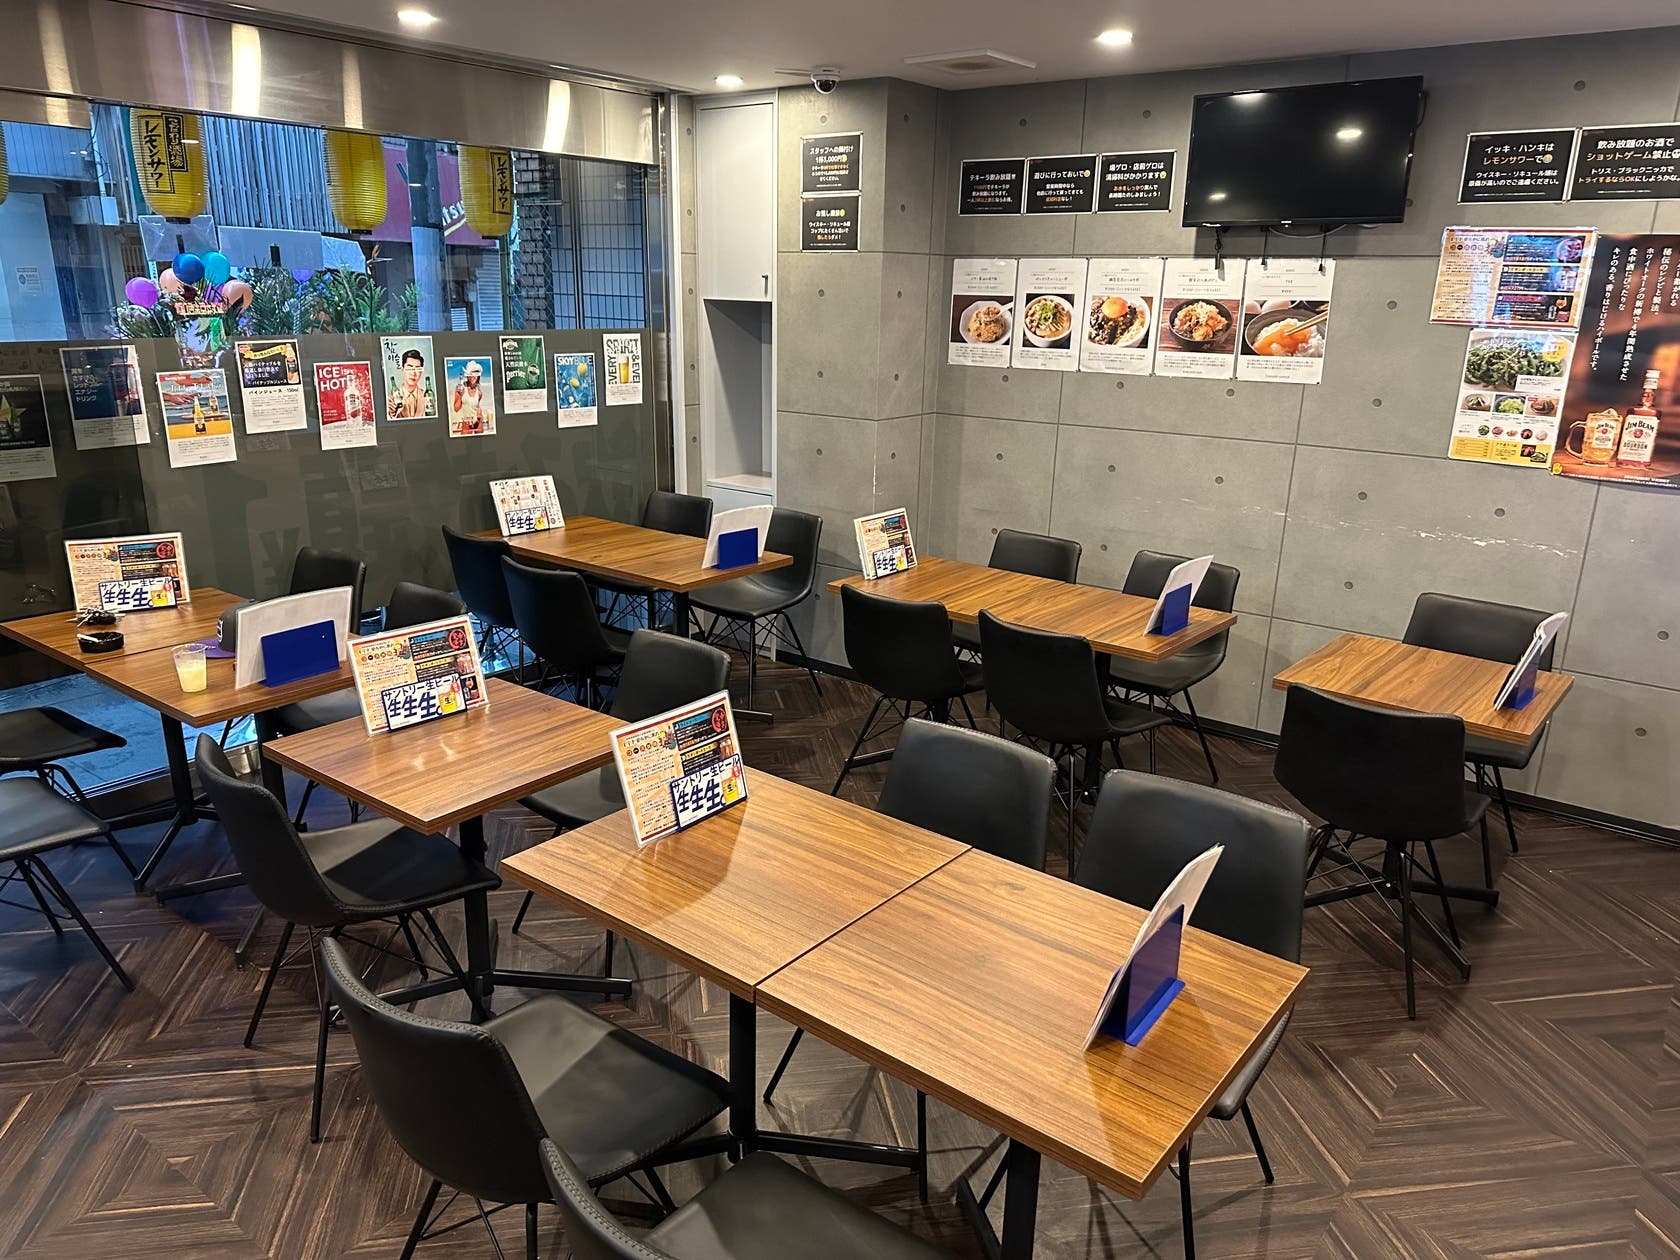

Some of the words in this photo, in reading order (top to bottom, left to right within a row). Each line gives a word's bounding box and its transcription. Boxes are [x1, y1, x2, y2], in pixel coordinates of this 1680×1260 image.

[1484, 143, 1555, 154] イッキ・ハンキは
[1596, 138, 1676, 149] 飲み放題のお酒で
[143, 120, 166, 188] レモンサワー
[1483, 155, 1543, 165] レモンサワーで
[1586, 149, 1672, 161] ショットゲーム禁止
[1591, 166, 1675, 175] トリス・ブラックニッカで
[496, 156, 510, 209] レモンサワー
[1618, 247, 1638, 311] 食中酒にぴったりな
[318, 367, 340, 378] ICE
[320, 378, 347, 392] HOT
[1625, 421, 1638, 431] JIM
[1638, 420, 1655, 433] BEAM
[1623, 441, 1648, 450] BOURBON
[100, 577, 173, 590] サントリー生ビール
[384, 674, 460, 702] サントリー生ビール
[671, 756, 740, 794] サントリー生ビール
